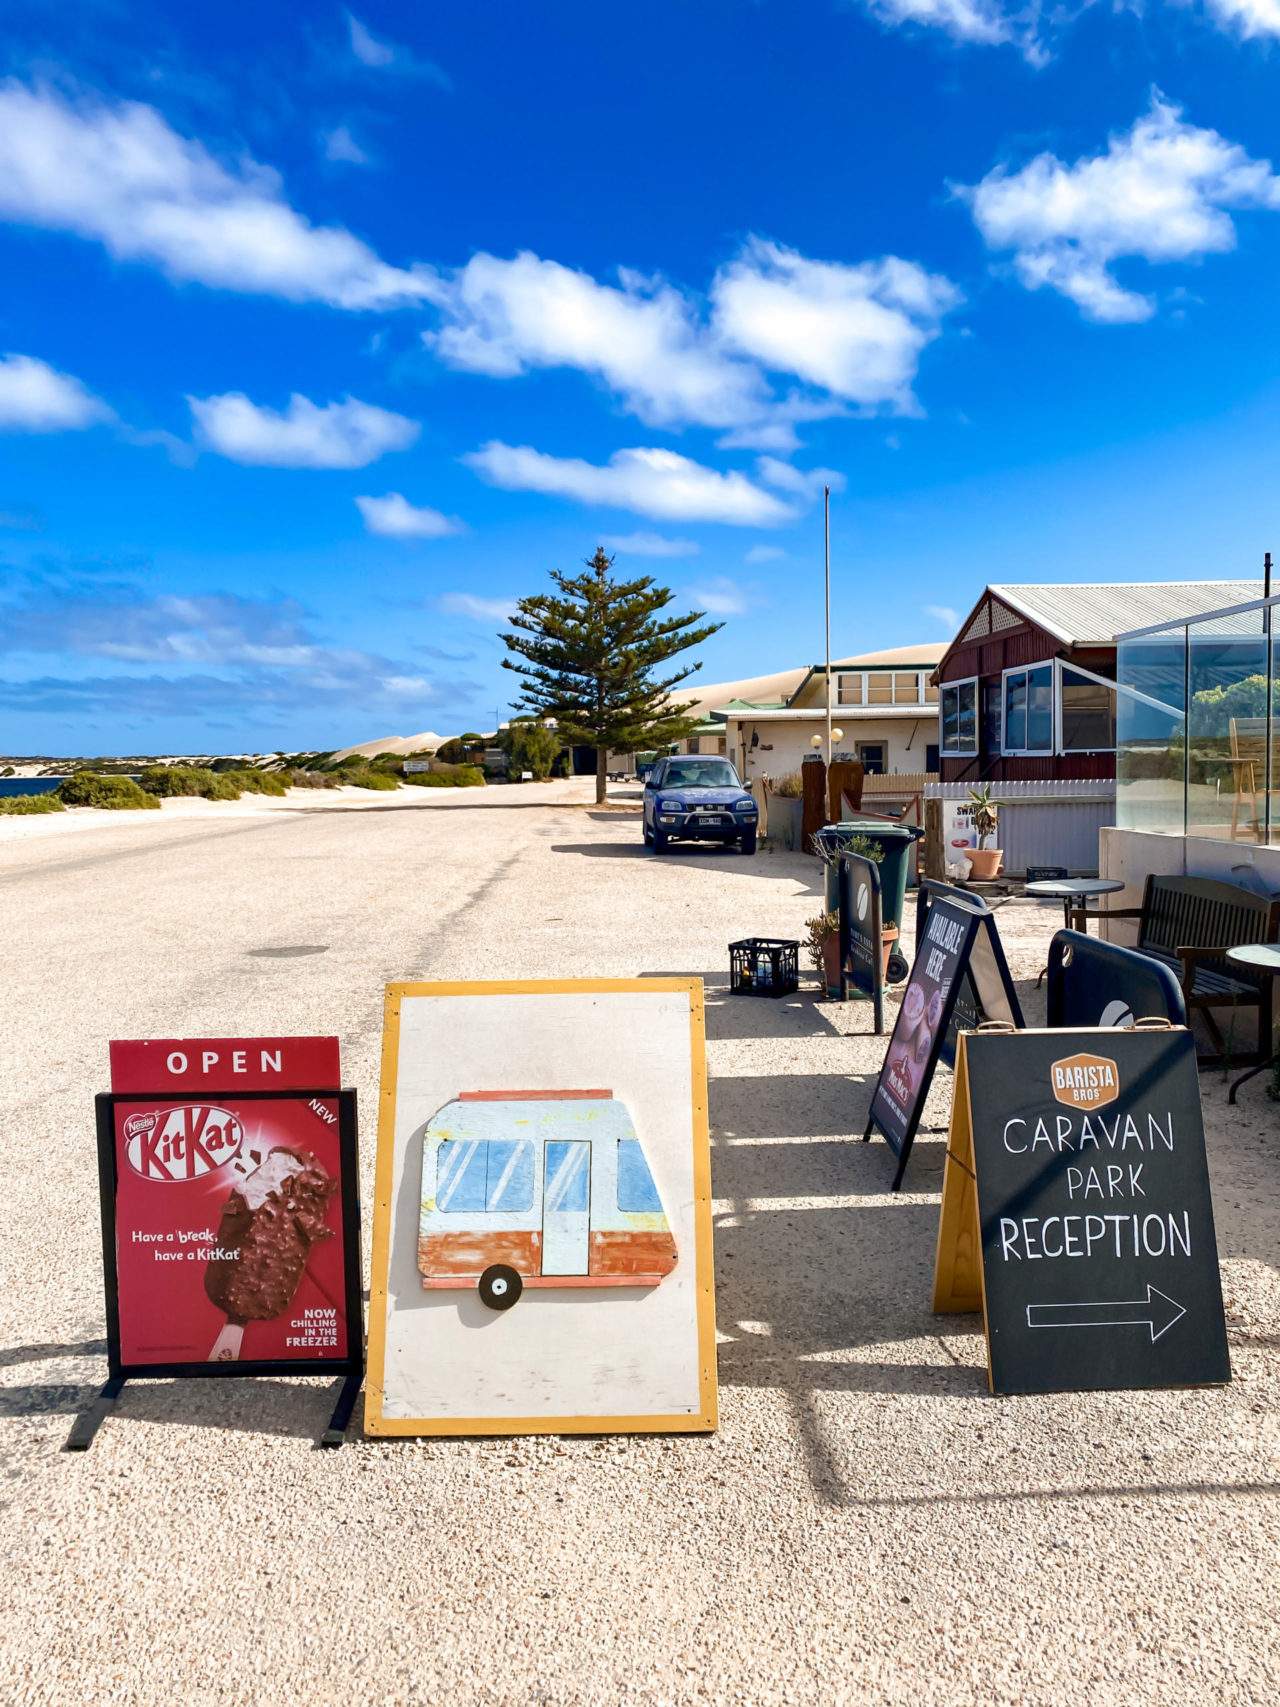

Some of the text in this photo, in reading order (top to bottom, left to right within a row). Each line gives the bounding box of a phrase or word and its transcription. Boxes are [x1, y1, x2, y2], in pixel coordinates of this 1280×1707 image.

[927, 912, 965, 955] AVAILABLE
[925, 946, 947, 983] HERE
[166, 1050, 282, 1075] OPEN
[1055, 1065, 1115, 1089] BARISTA
[1073, 1088, 1100, 1101] BROS
[308, 1098, 338, 1125] NEW
[139, 1107, 239, 1181] KitKat
[1003, 1111, 1174, 1154] CARAVAN
[1067, 1163, 1146, 1200] PARK
[132, 1228, 218, 1243] Have a break,
[1000, 1211, 1191, 1262] RECEPTION
[154, 1248, 240, 1261] have a KitKat
[290, 1320, 337, 1328] CHILLING
[304, 1309, 336, 1319] NOW
[286, 1337, 338, 1347] FREEZER
[305, 1328, 337, 1336] IN THE
